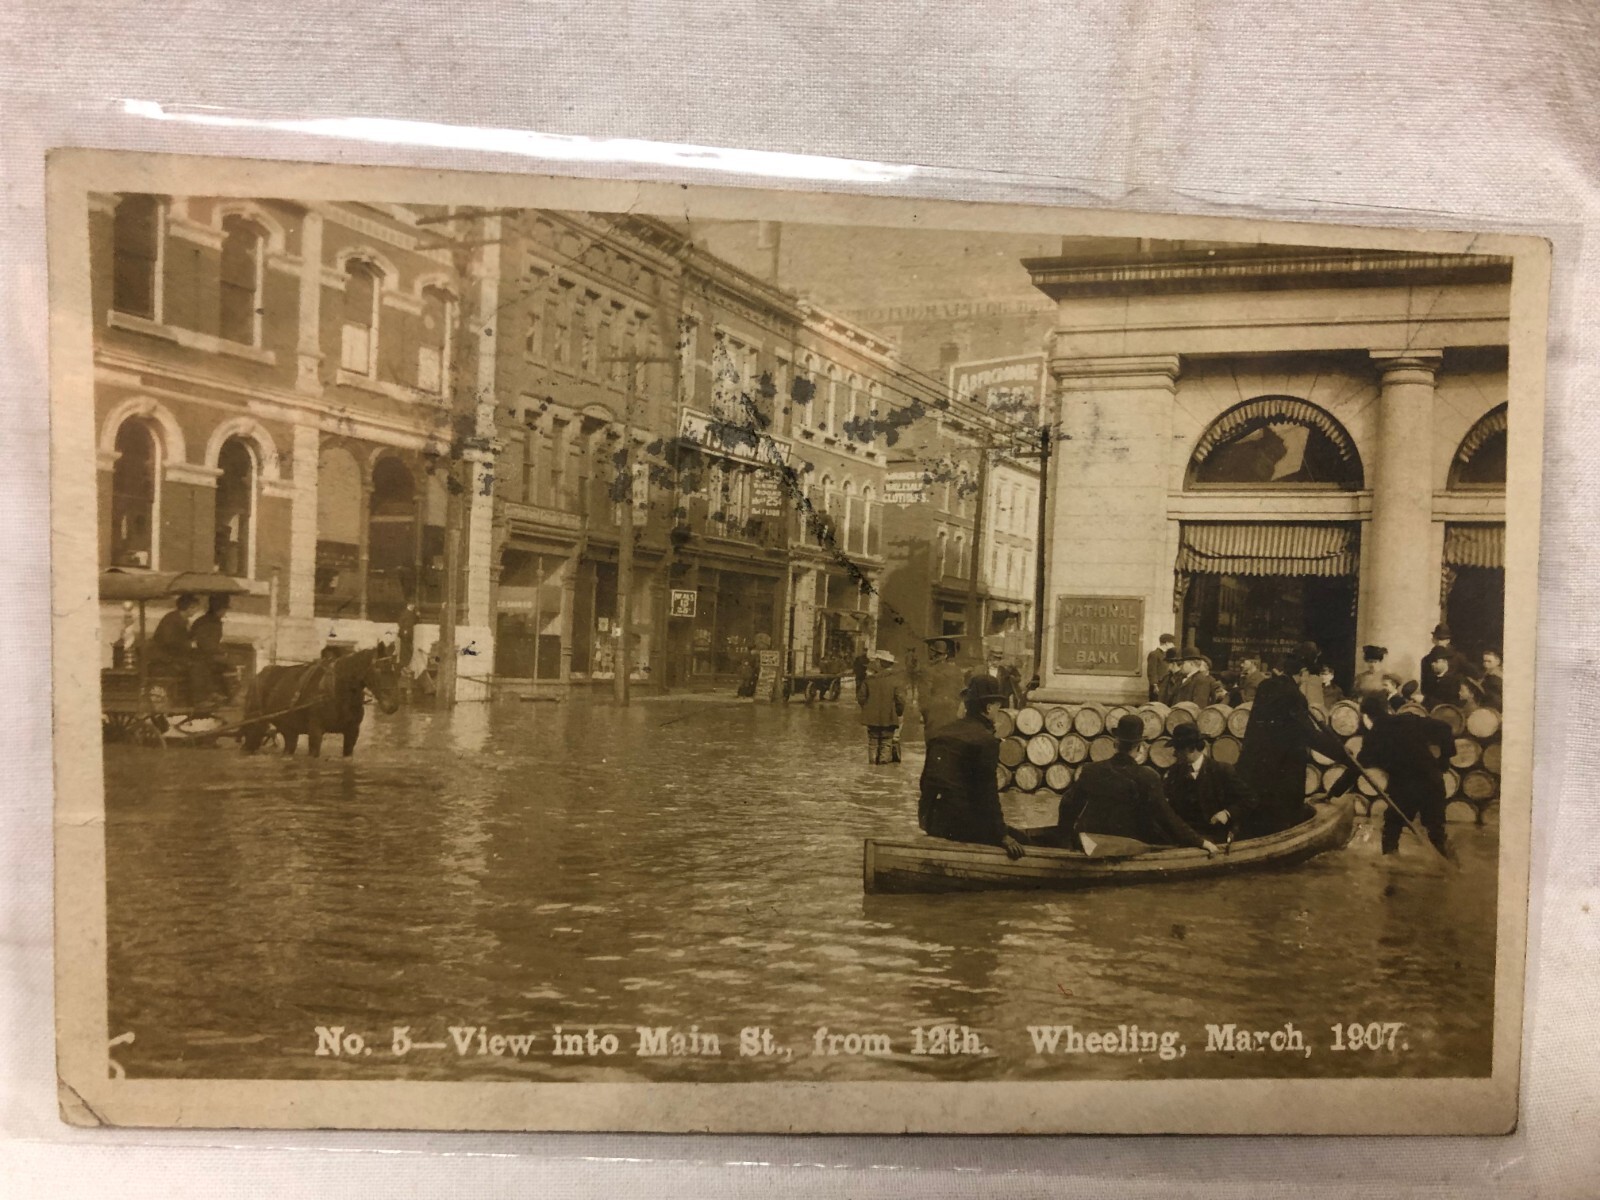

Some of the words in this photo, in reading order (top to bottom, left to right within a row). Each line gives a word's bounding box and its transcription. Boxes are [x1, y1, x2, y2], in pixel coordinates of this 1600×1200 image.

[1064, 604, 1136, 618] NATIONAL
[1062, 622, 1137, 646] EXCHANGE
[1076, 650, 1120, 664] BANK
